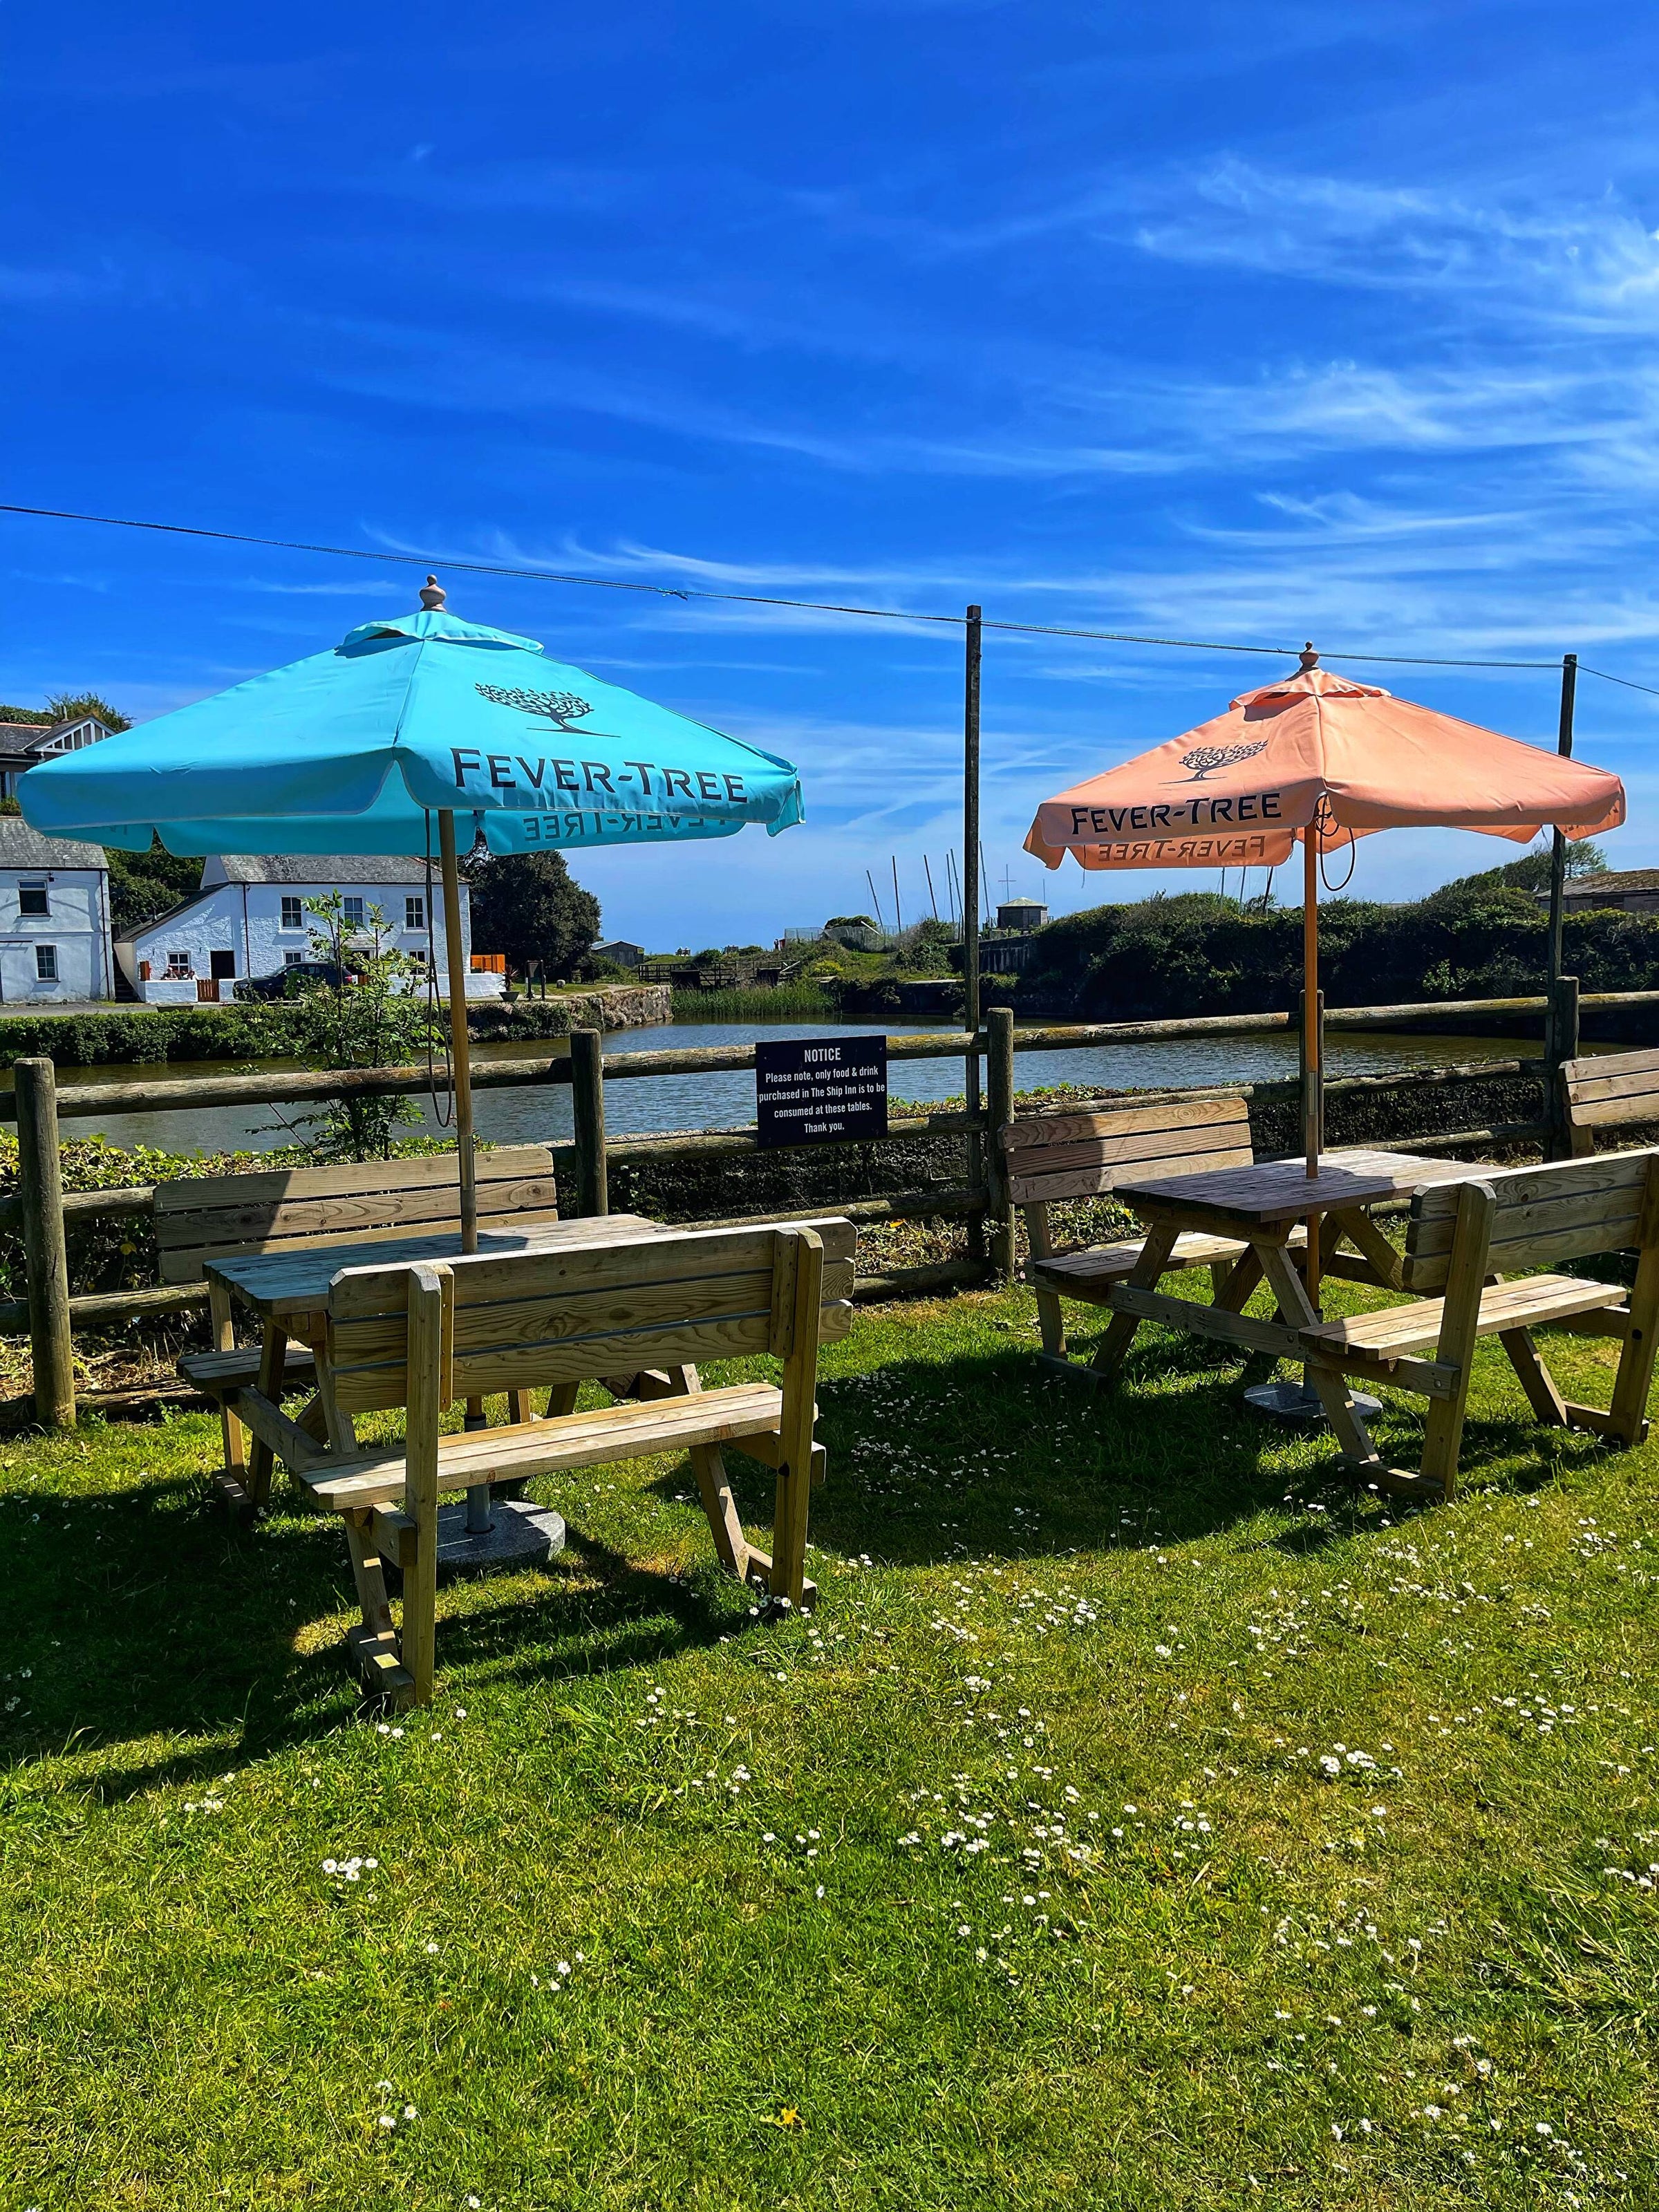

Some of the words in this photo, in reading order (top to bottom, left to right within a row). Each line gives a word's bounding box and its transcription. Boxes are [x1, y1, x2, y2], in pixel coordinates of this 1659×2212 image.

[449, 747, 748, 803] FEVER-TREE
[1069, 792, 1282, 835] FEVER-TREE
[804, 1048, 841, 1062] NOTICE
[765, 1073, 791, 1083] Please
[794, 1072, 814, 1081] note,
[815, 1069, 831, 1080] only
[833, 1068, 850, 1078] food
[852, 1067, 857, 1076] &
[859, 1066, 879, 1076] drink
[759, 1089, 800, 1103] purchased
[802, 1088, 809, 1098] in
[811, 1087, 825, 1098] The
[827, 1086, 843, 1097] Ship
[845, 1085, 856, 1095] Inn
[859, 1084, 865, 1094] is
[867, 1084, 874, 1093] to
[877, 1083, 885, 1092] be
[774, 1106, 814, 1118] consumed
[815, 1105, 823, 1114] at
[825, 1104, 845, 1114] these
[847, 1101, 872, 1112] tables.
[804, 1123, 827, 1133] Thank
[829, 1123, 845, 1133] you.
